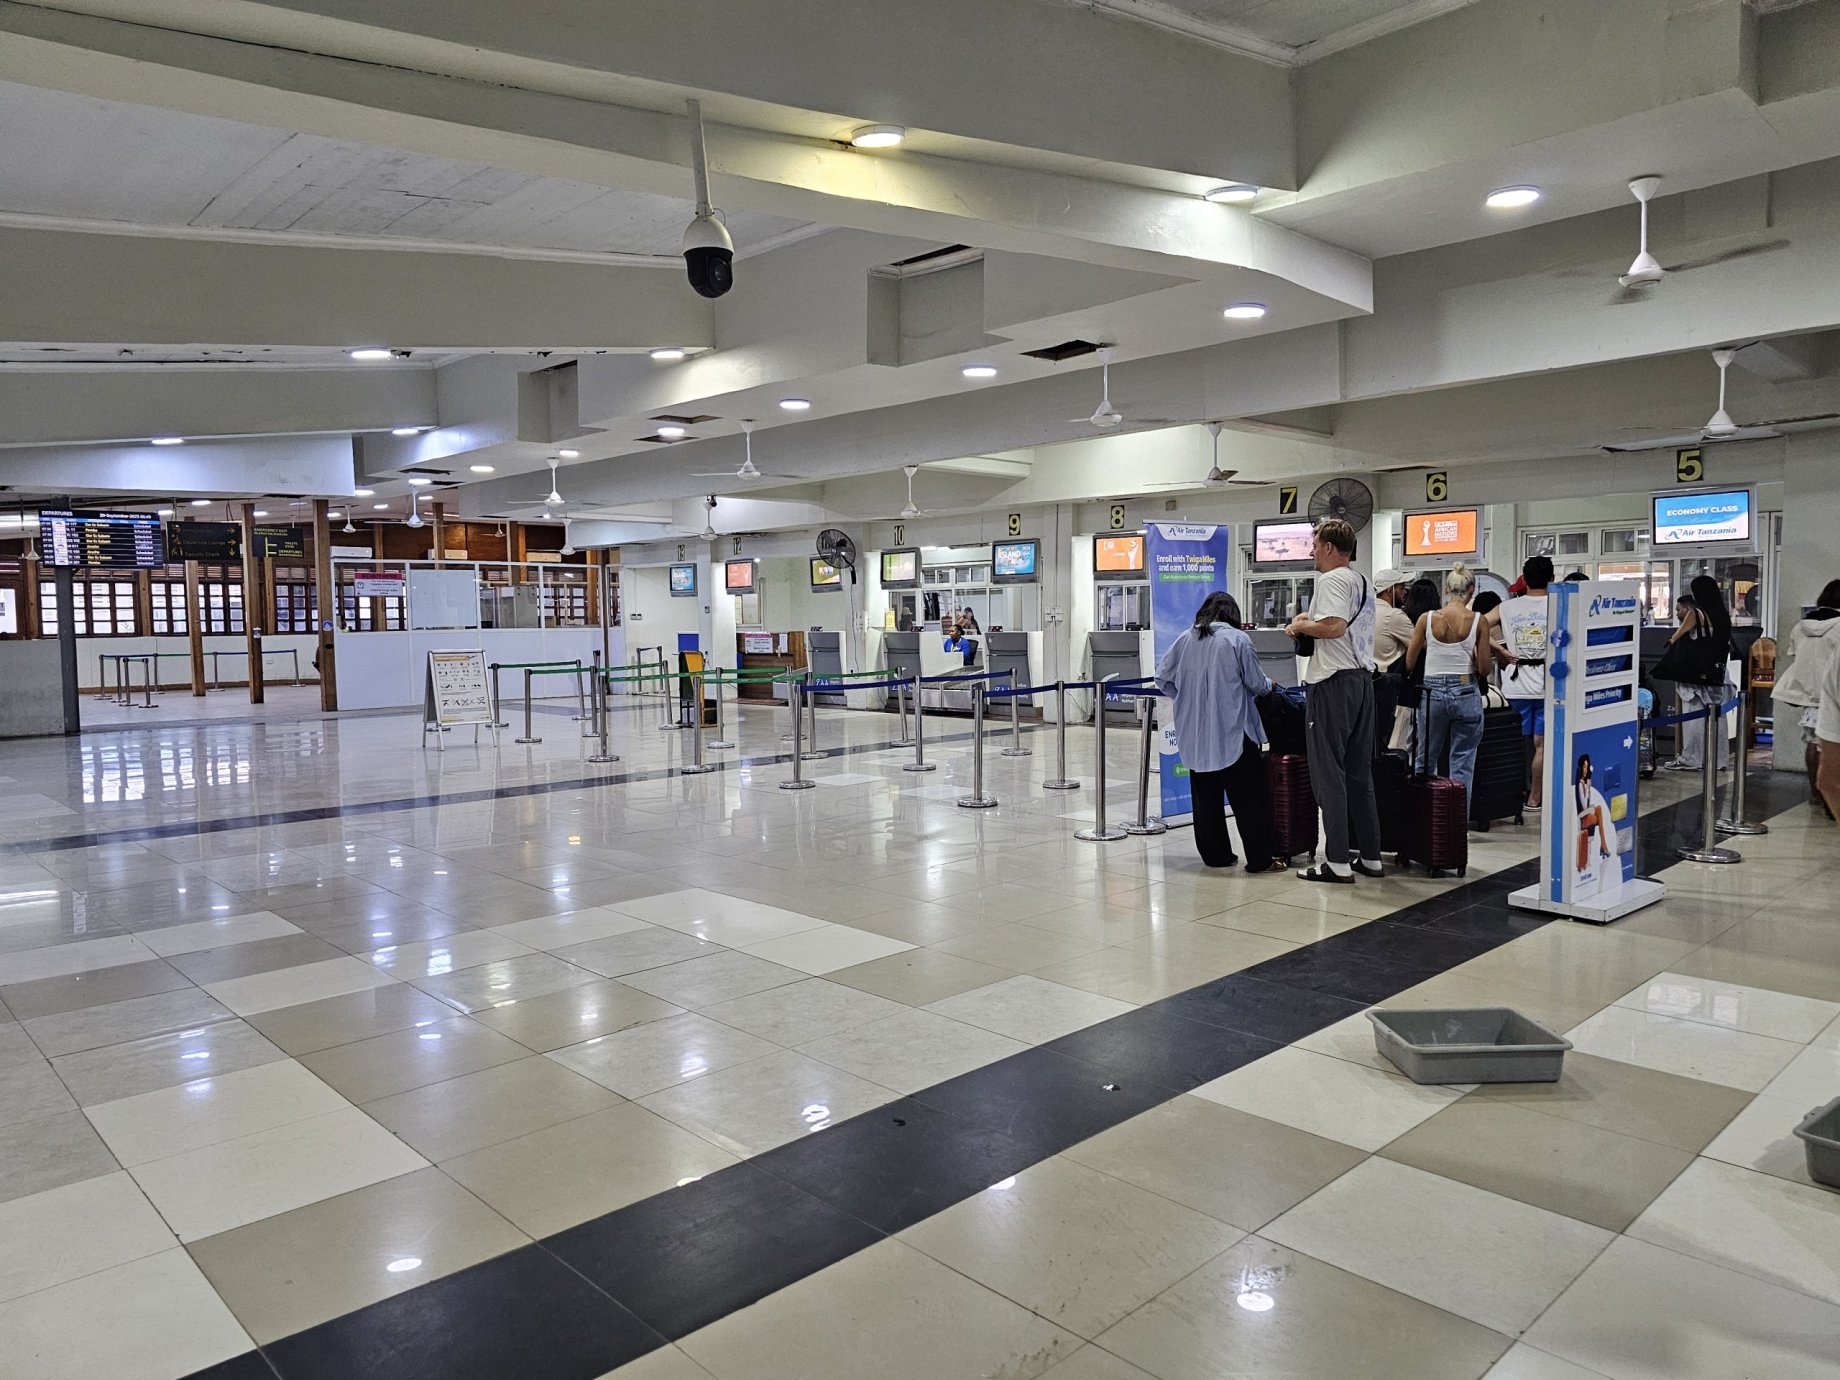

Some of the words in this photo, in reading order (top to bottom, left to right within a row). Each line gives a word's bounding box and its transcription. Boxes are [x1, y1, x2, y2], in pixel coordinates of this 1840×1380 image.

[1678, 450, 1702, 481] 5
[1427, 473, 1447, 501] 6
[1281, 488, 1296, 513] 7
[1111, 506, 1124, 528] 8
[1666, 507, 1709, 516] ECONOMY
[1710, 505, 1738, 513] CLASS
[1009, 515, 1020, 535] 9
[1698, 527, 1737, 535] Tanzania
[895, 526, 904, 545] 10
[678, 545, 685, 561] 13
[734, 538, 741, 555] 12
[1156, 554, 1173, 563] Enroll
[1173, 555, 1186, 563] with
[1158, 563, 1169, 571] and
[1182, 564, 1199, 573] 1,000
[1199, 564, 1215, 573] points
[1602, 597, 1611, 608] Air
